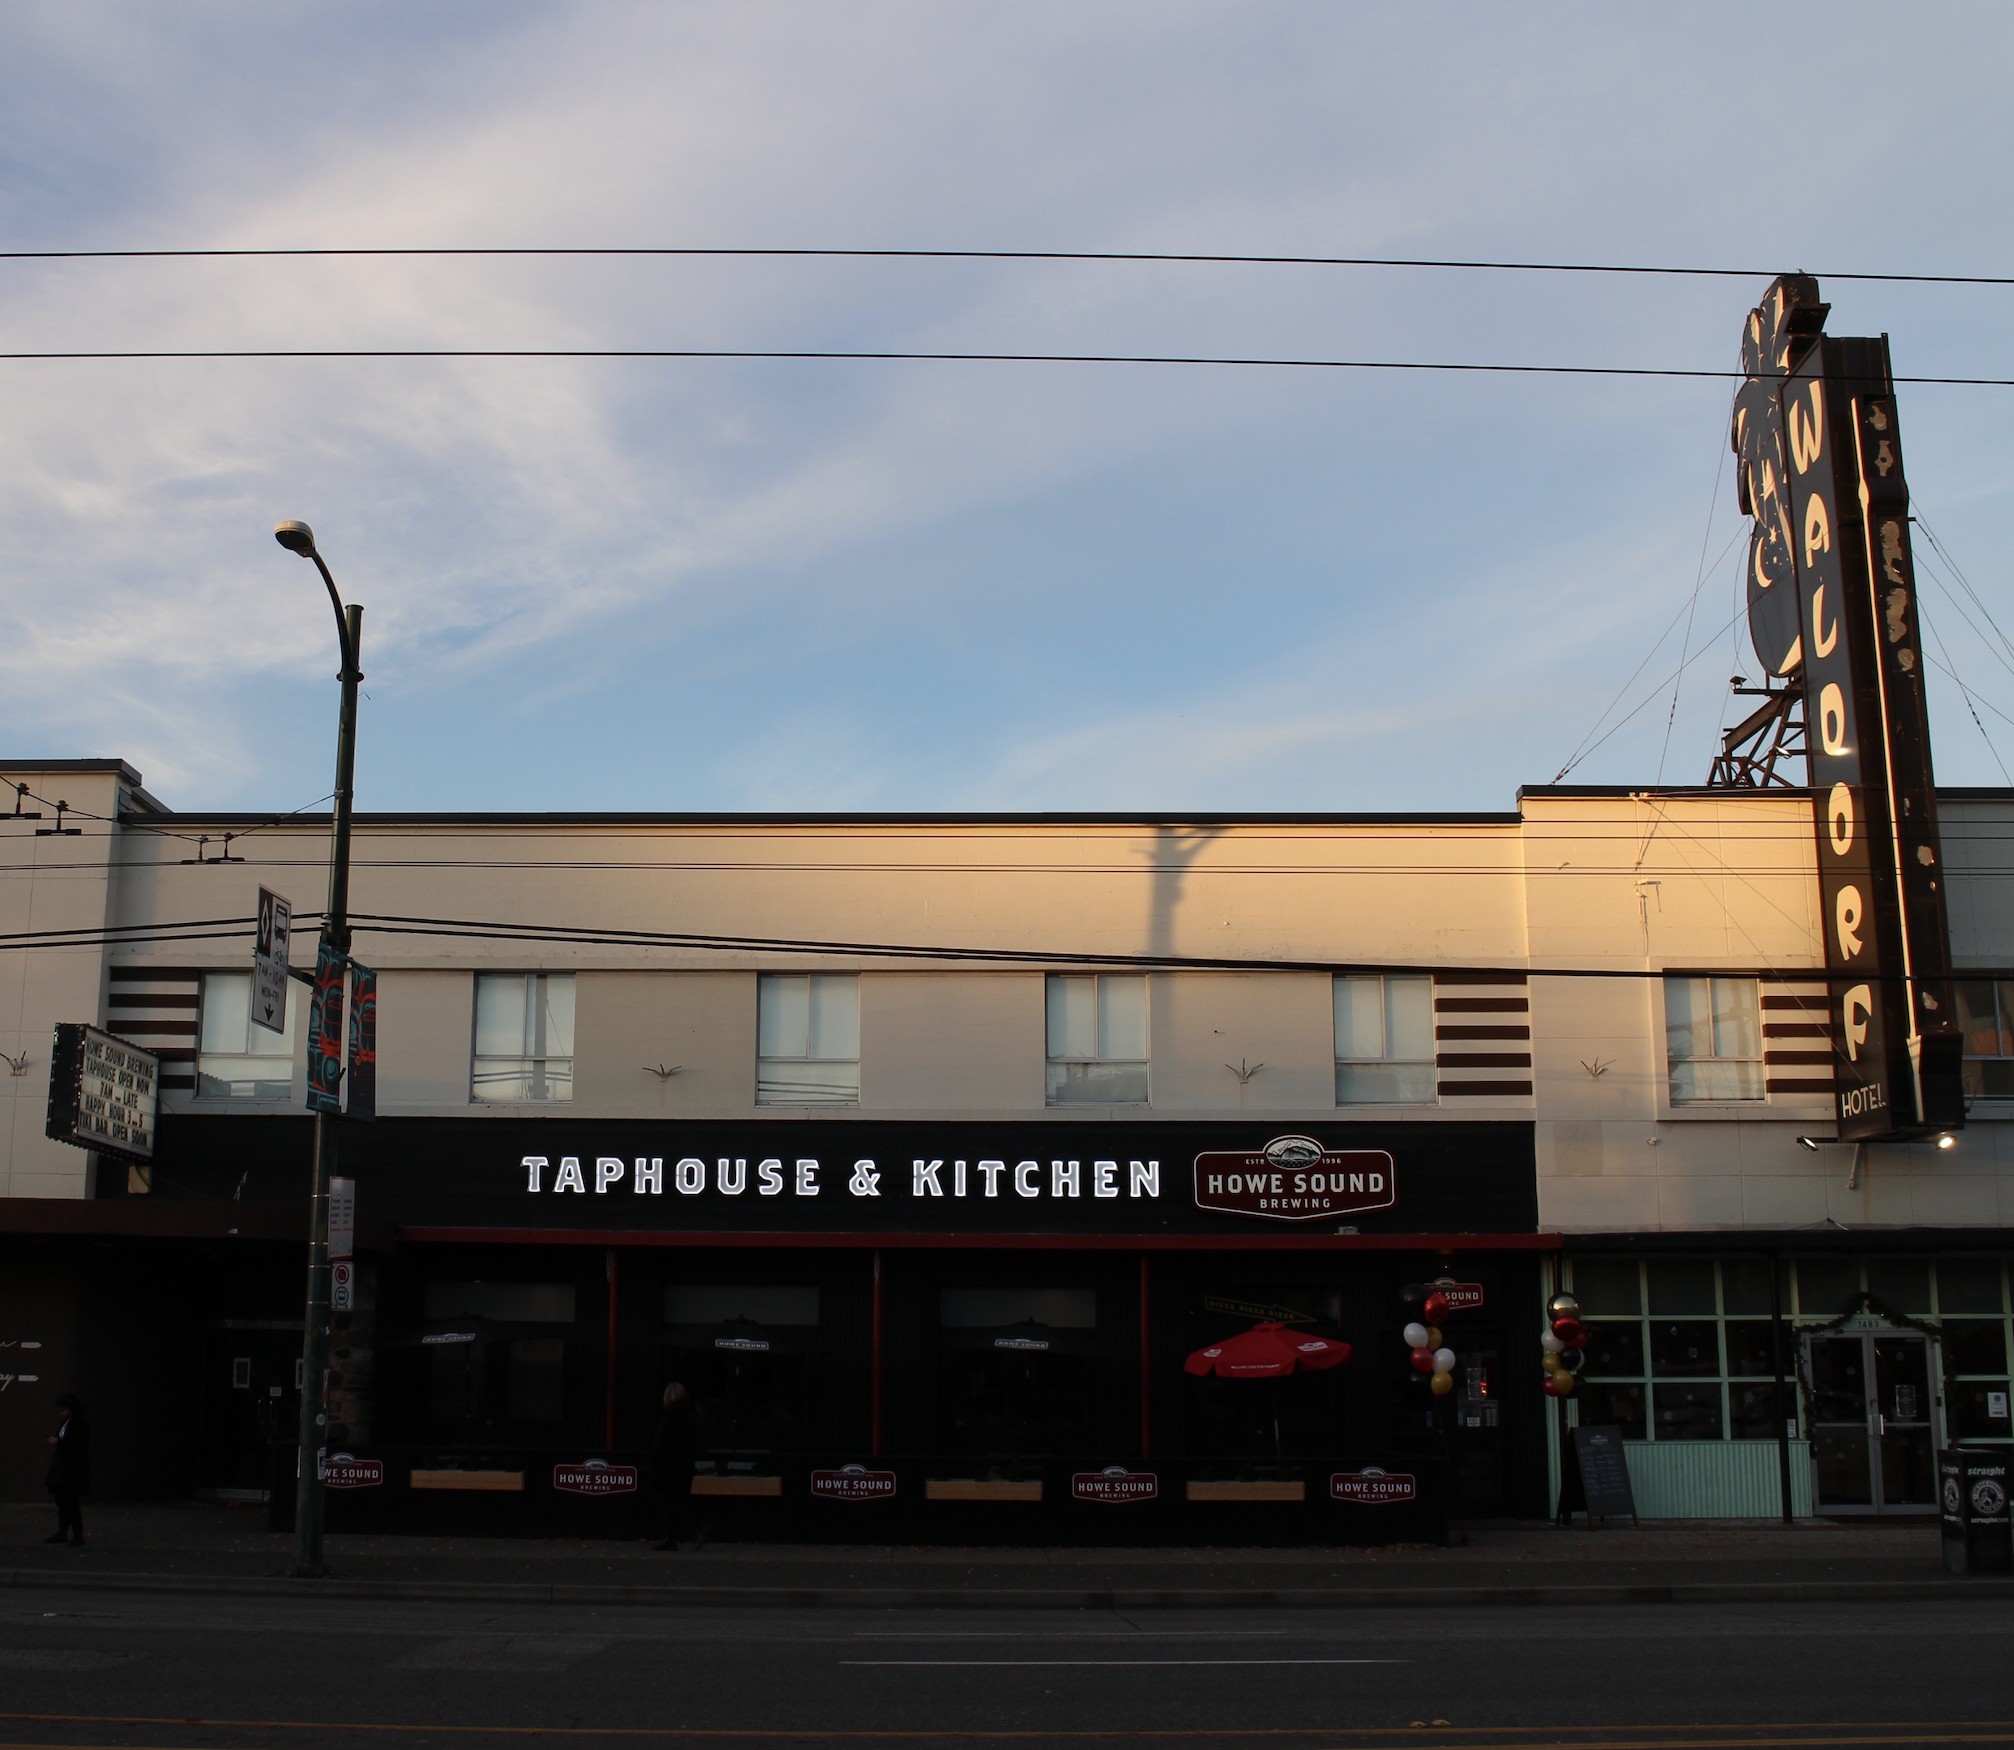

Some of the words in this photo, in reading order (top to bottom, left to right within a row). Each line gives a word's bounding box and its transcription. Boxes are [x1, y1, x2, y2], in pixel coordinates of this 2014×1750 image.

[1789, 380, 1872, 1062] WALDORF
[86, 1039, 102, 1059] HOWE
[105, 1046, 125, 1067] SOUND
[127, 1055, 153, 1079] BREWING
[86, 1058, 116, 1082] TAPHOUSE
[119, 1070, 133, 1089] OPEN
[100, 1082, 113, 1100] 7AM
[123, 1091, 137, 1109] LATE
[1842, 1083, 1886, 1118] HOTEL
[86, 1095, 105, 1115] HAPPY
[110, 1103, 125, 1122] HOUR
[80, 1111, 91, 1129] TIKI
[96, 1117, 108, 1134] BAR
[113, 1123, 127, 1141] OPEN
[132, 1130, 147, 1148] SOON
[520, 1156, 820, 1196] TAPHOUSE
[849, 1159, 881, 1197] &
[912, 1160, 1161, 1198] KITCHEN
[1208, 1174, 1283, 1193] HOWE
[1294, 1173, 1384, 1193] SOUND
[1260, 1198, 1330, 1209] BREWING
[1445, 1292, 1479, 1300] SOUND
[342, 1469, 379, 1478] SOUND
[560, 1474, 591, 1484] HOWE
[595, 1475, 633, 1485] SOUND
[1967, 1467, 2005, 1476] straight
[817, 1480, 849, 1489] HOWE
[853, 1480, 892, 1490] SOUND
[1078, 1483, 1110, 1492] HOWE
[1115, 1483, 1153, 1492] SOUND
[1336, 1483, 1369, 1492] HOWE
[1373, 1483, 1411, 1493] SOUND
